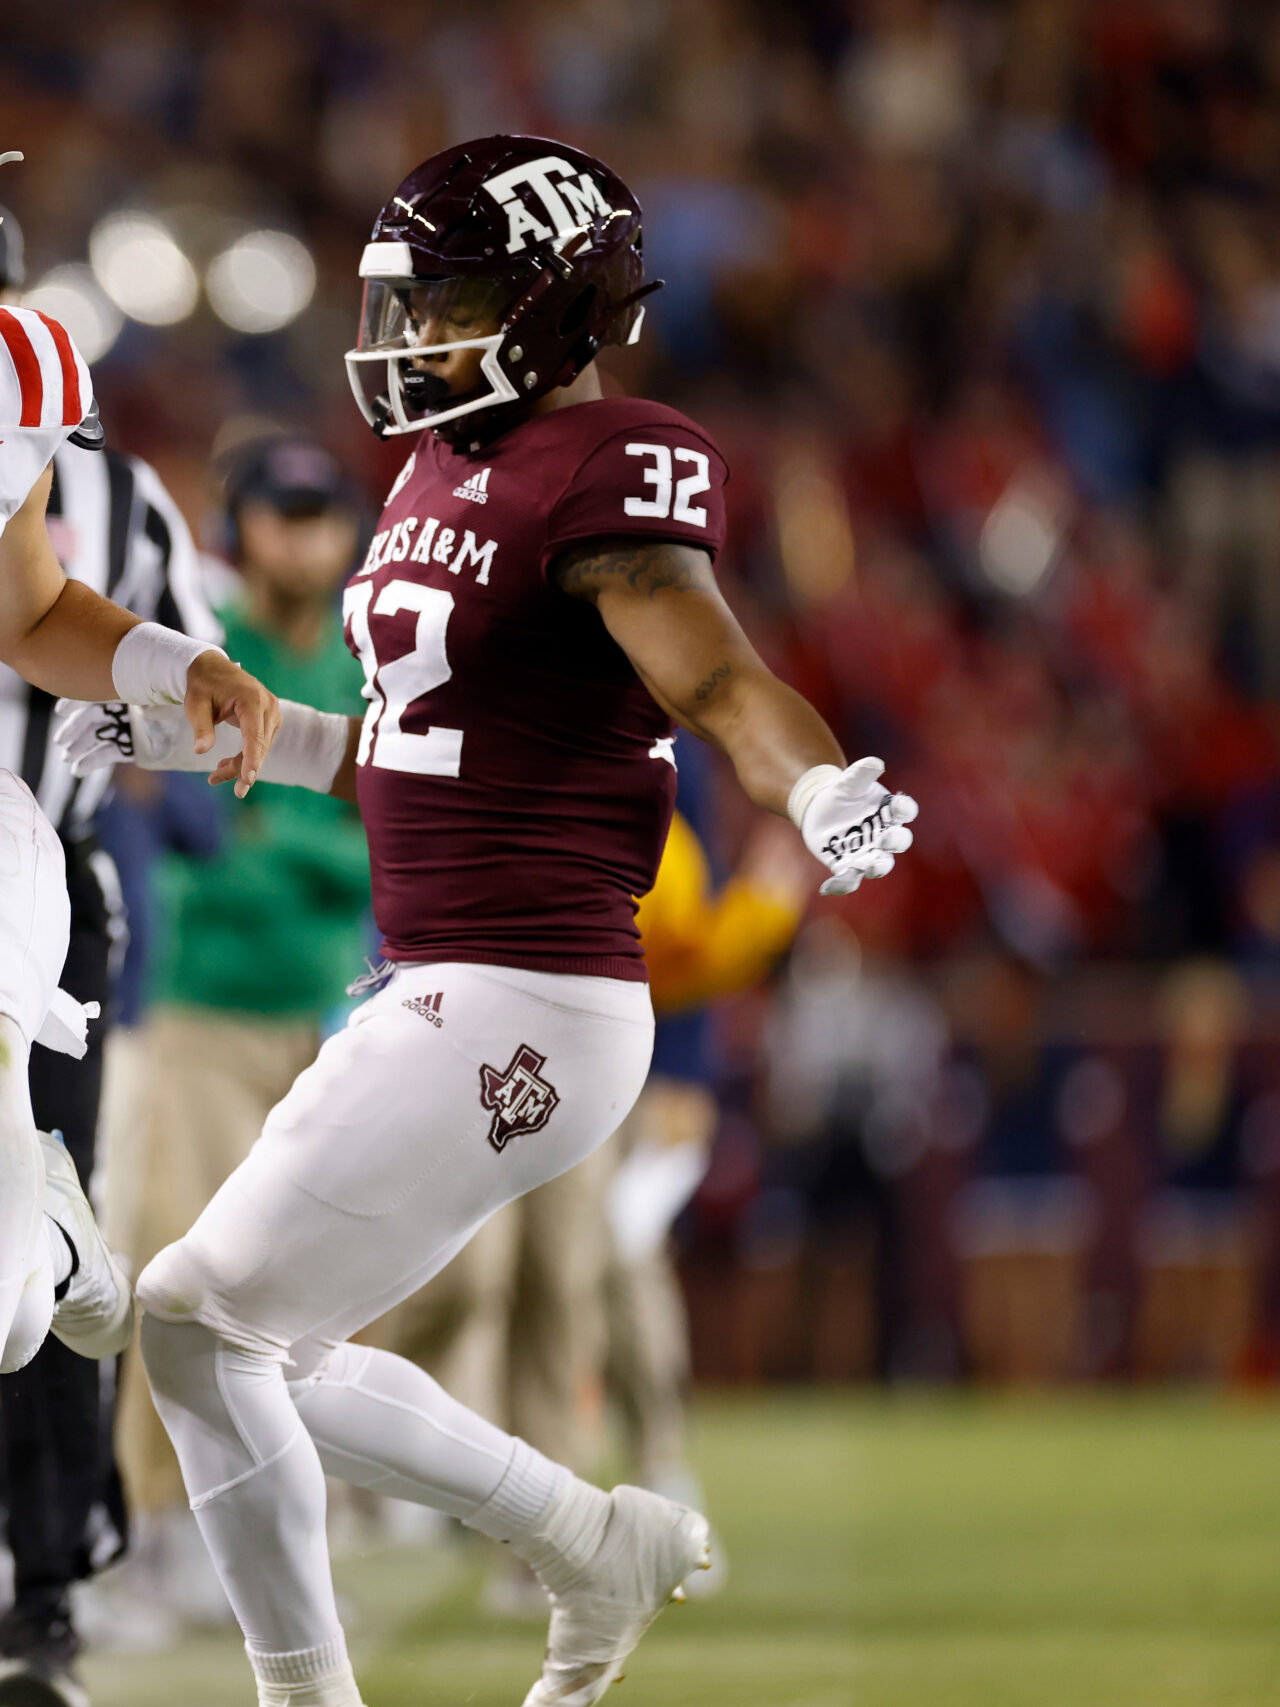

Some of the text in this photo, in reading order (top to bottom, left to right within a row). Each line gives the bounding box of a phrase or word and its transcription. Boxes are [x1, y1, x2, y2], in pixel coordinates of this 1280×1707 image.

[452, 486, 489, 505] adidas
[624, 442, 711, 529] 32
[409, 516, 499, 586] A&M
[401, 998, 445, 1028] adidas
